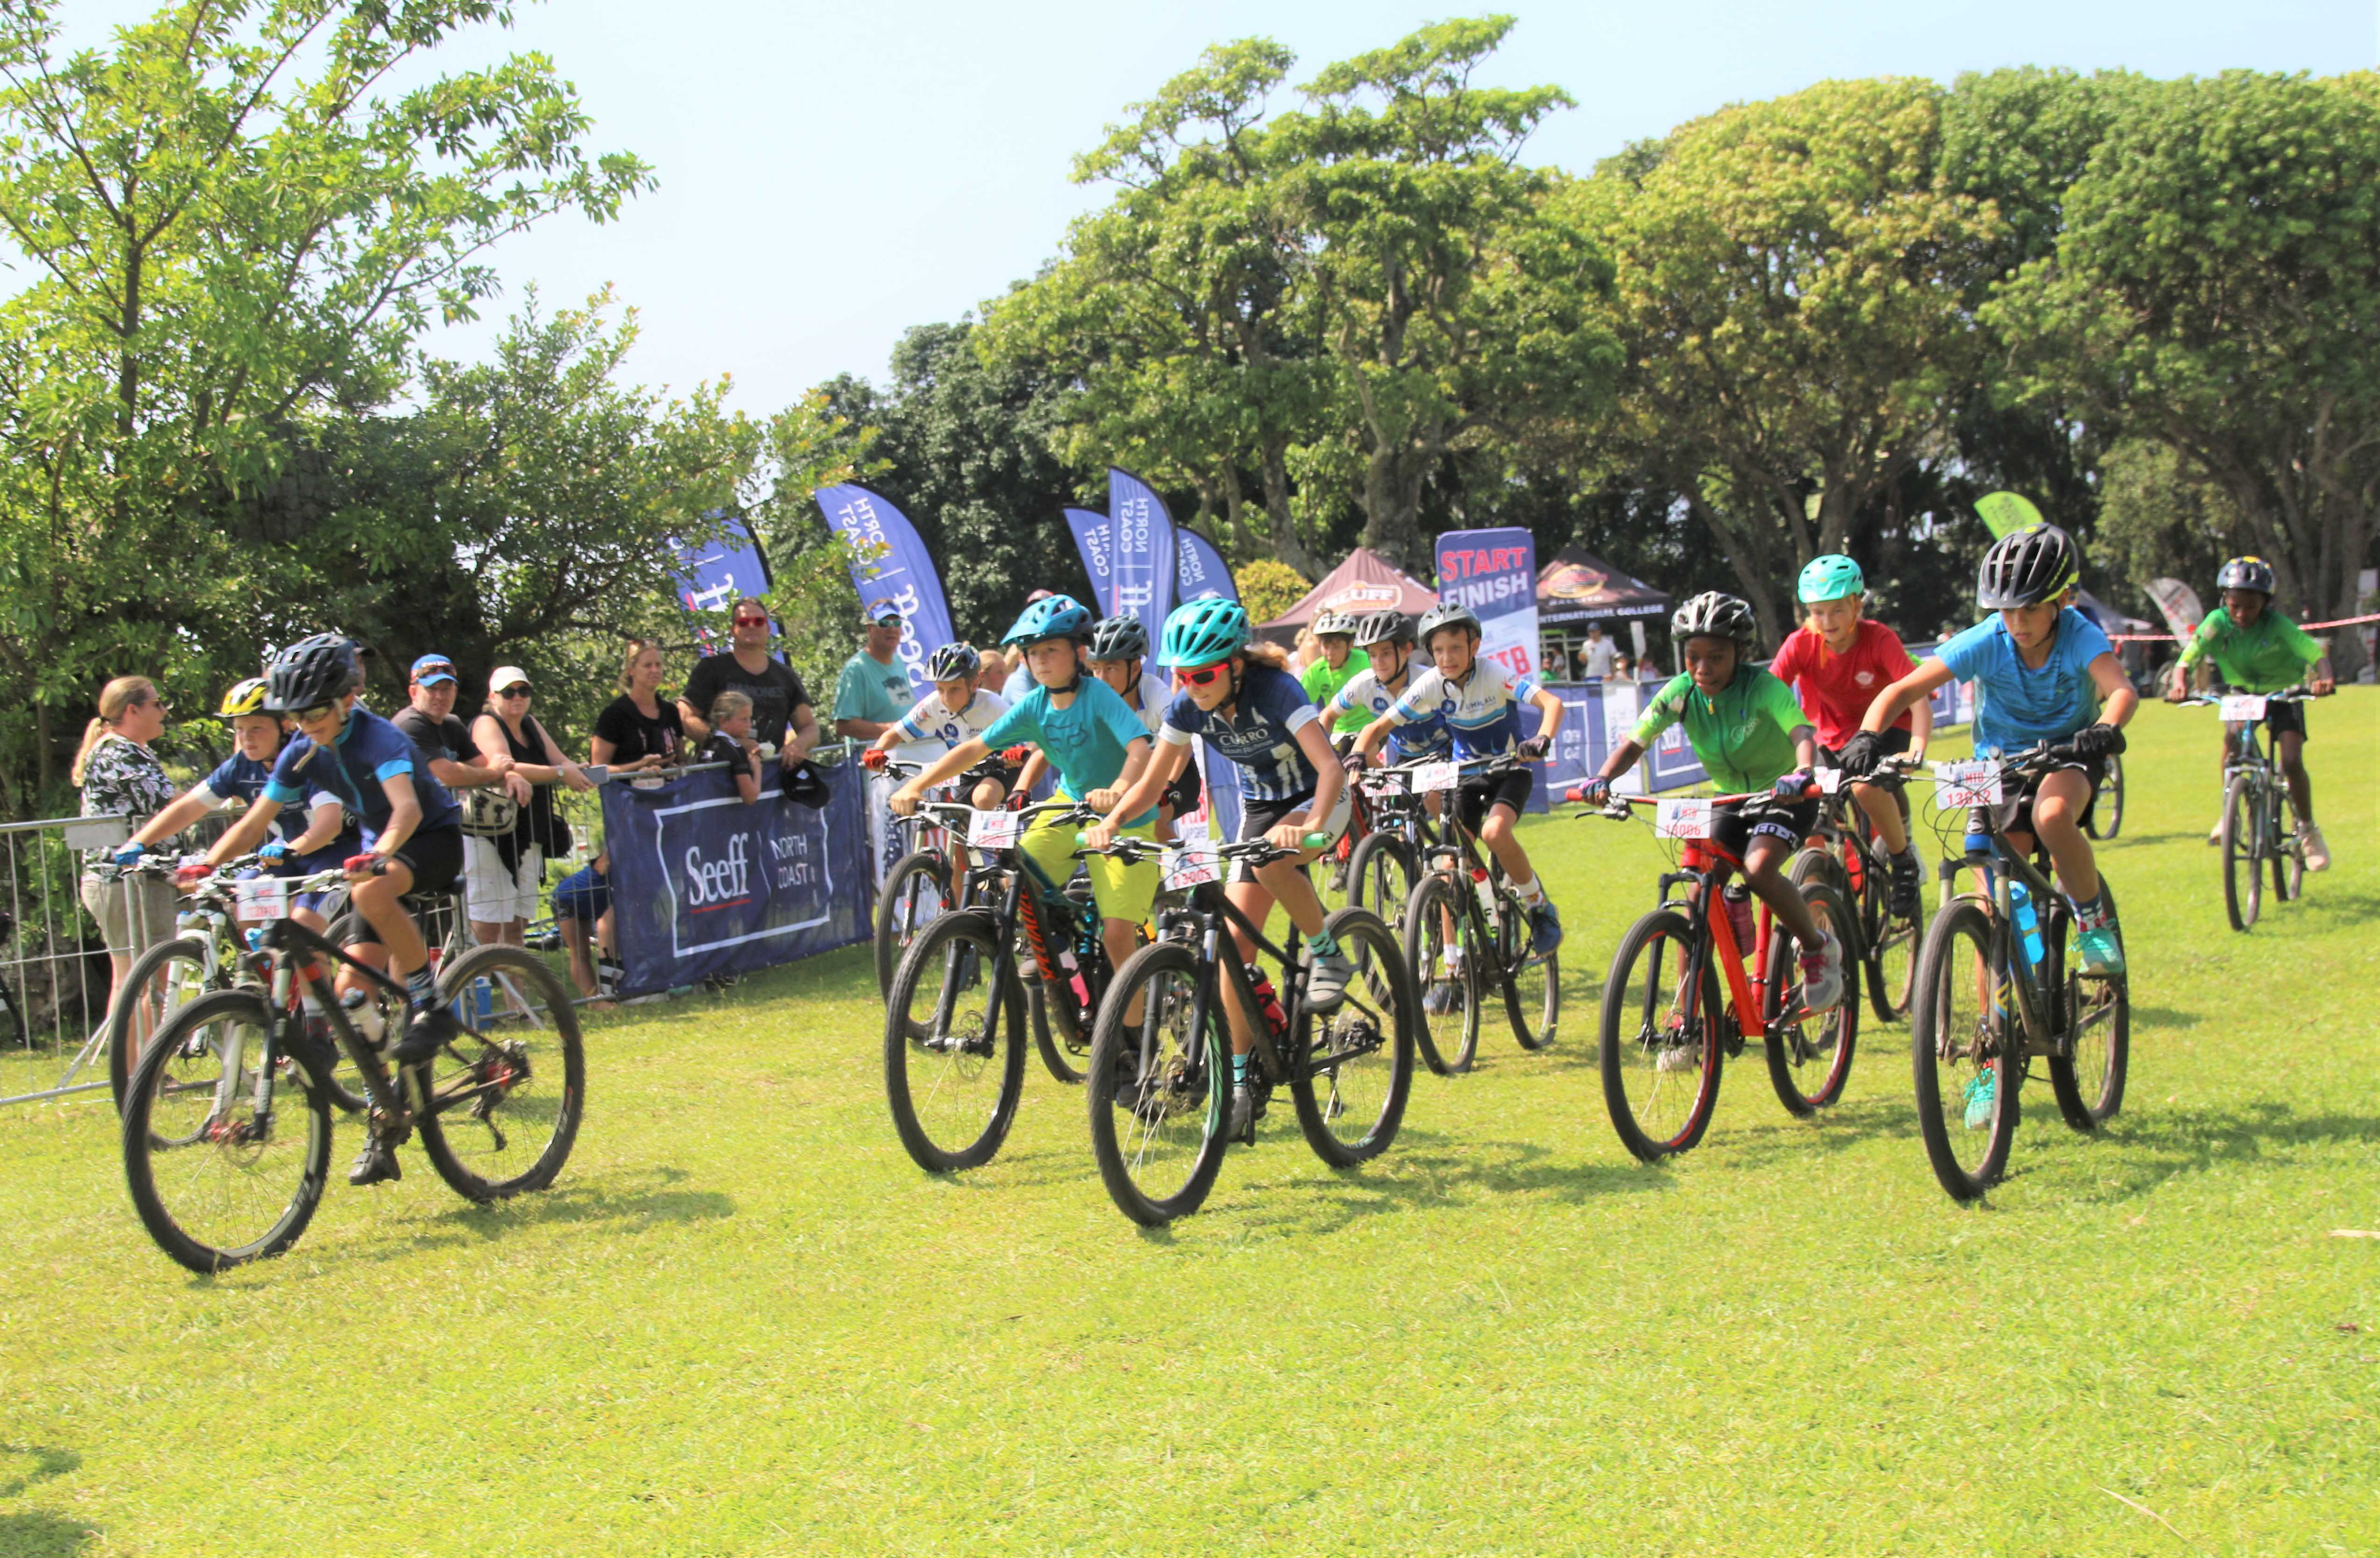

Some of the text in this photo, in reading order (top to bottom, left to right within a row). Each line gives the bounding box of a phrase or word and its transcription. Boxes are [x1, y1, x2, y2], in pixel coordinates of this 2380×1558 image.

[1441, 547, 1527, 583] START
[1444, 571, 1528, 608] FINISH
[1616, 603, 1664, 616] COLLEGE
[1219, 728, 1269, 746] CURRO
[1665, 824, 1701, 836] 13006
[769, 833, 808, 860] NORTH
[685, 832, 750, 905] Seeff
[777, 863, 808, 889] COAST
